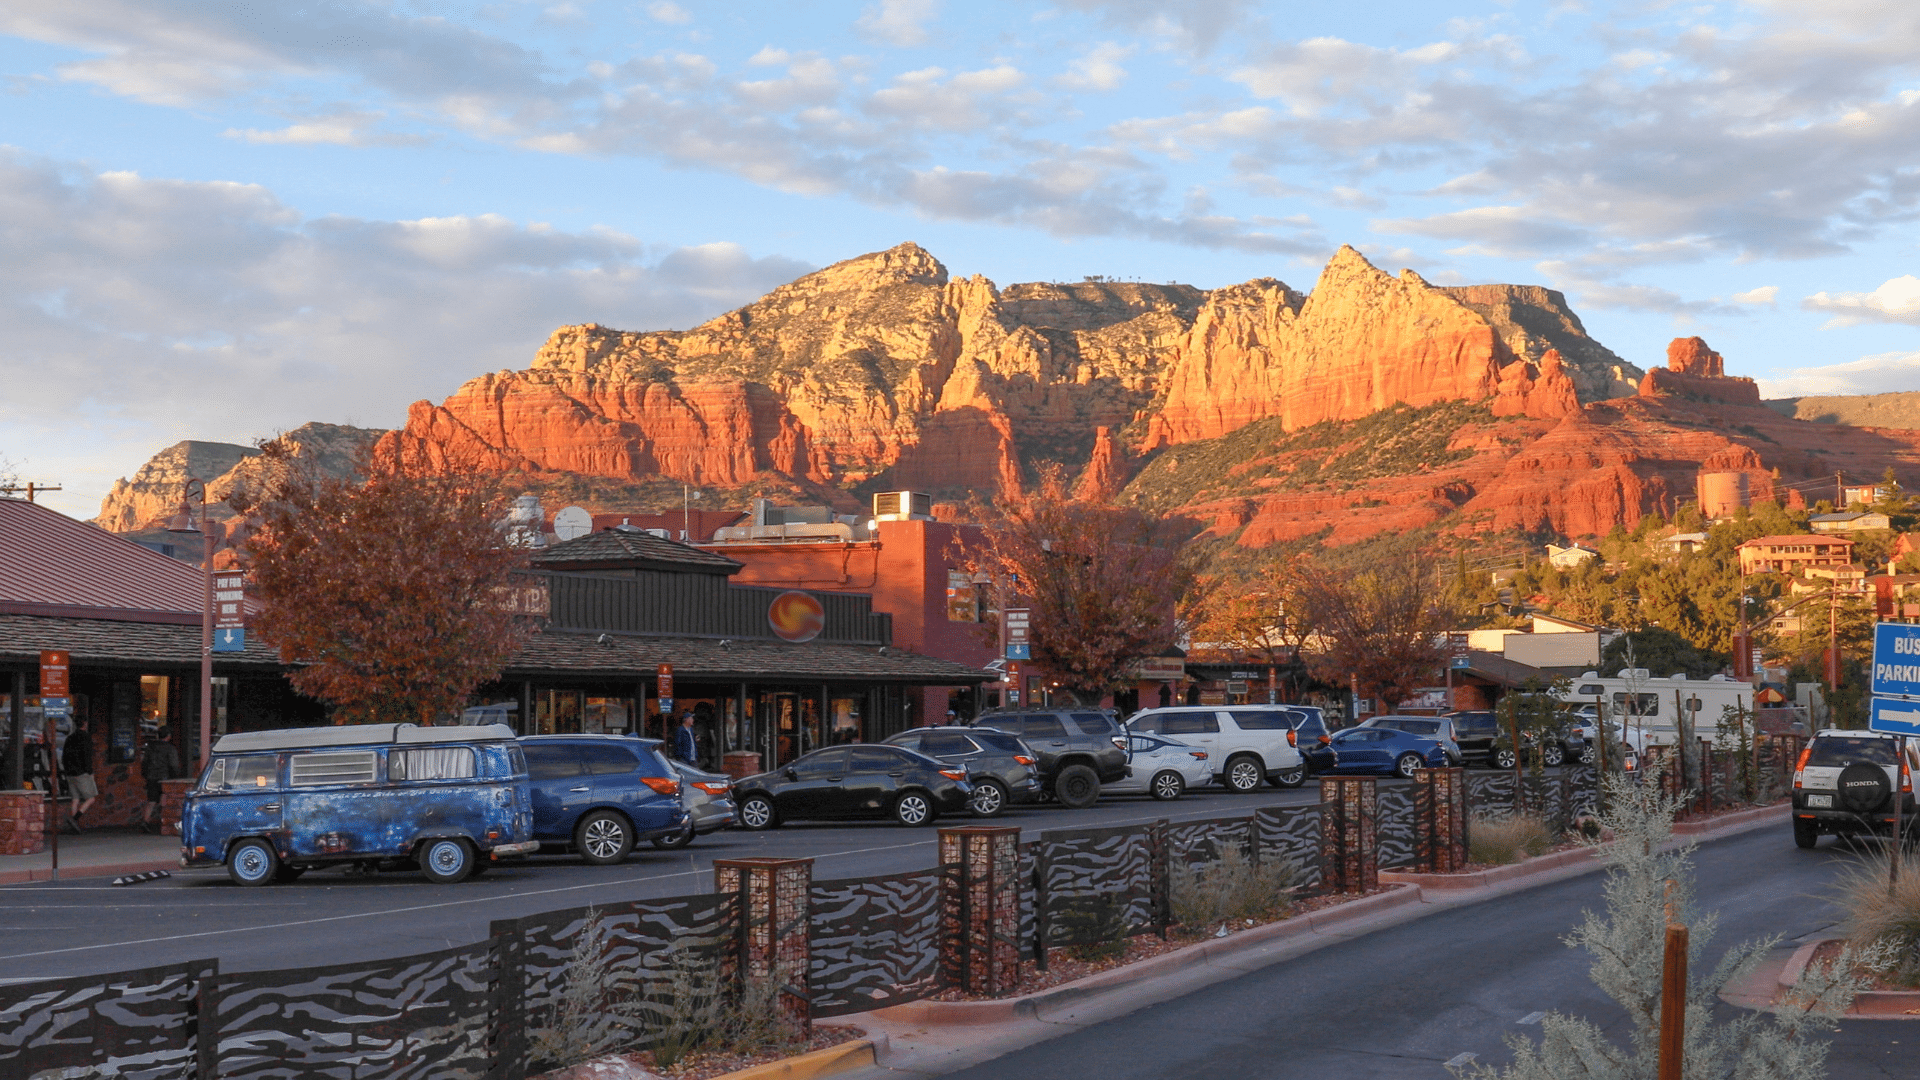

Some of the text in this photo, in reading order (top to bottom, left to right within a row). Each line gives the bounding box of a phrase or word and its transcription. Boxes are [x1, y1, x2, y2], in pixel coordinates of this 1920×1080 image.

[217, 577, 242, 588] PAY FOR
[216, 590, 243, 601] PARKING
[222, 604, 237, 614] HERE
[1894, 637, 1920, 656] BUS
[1876, 663, 1920, 683] PARKI
[1845, 780, 1880, 788] HONDA
